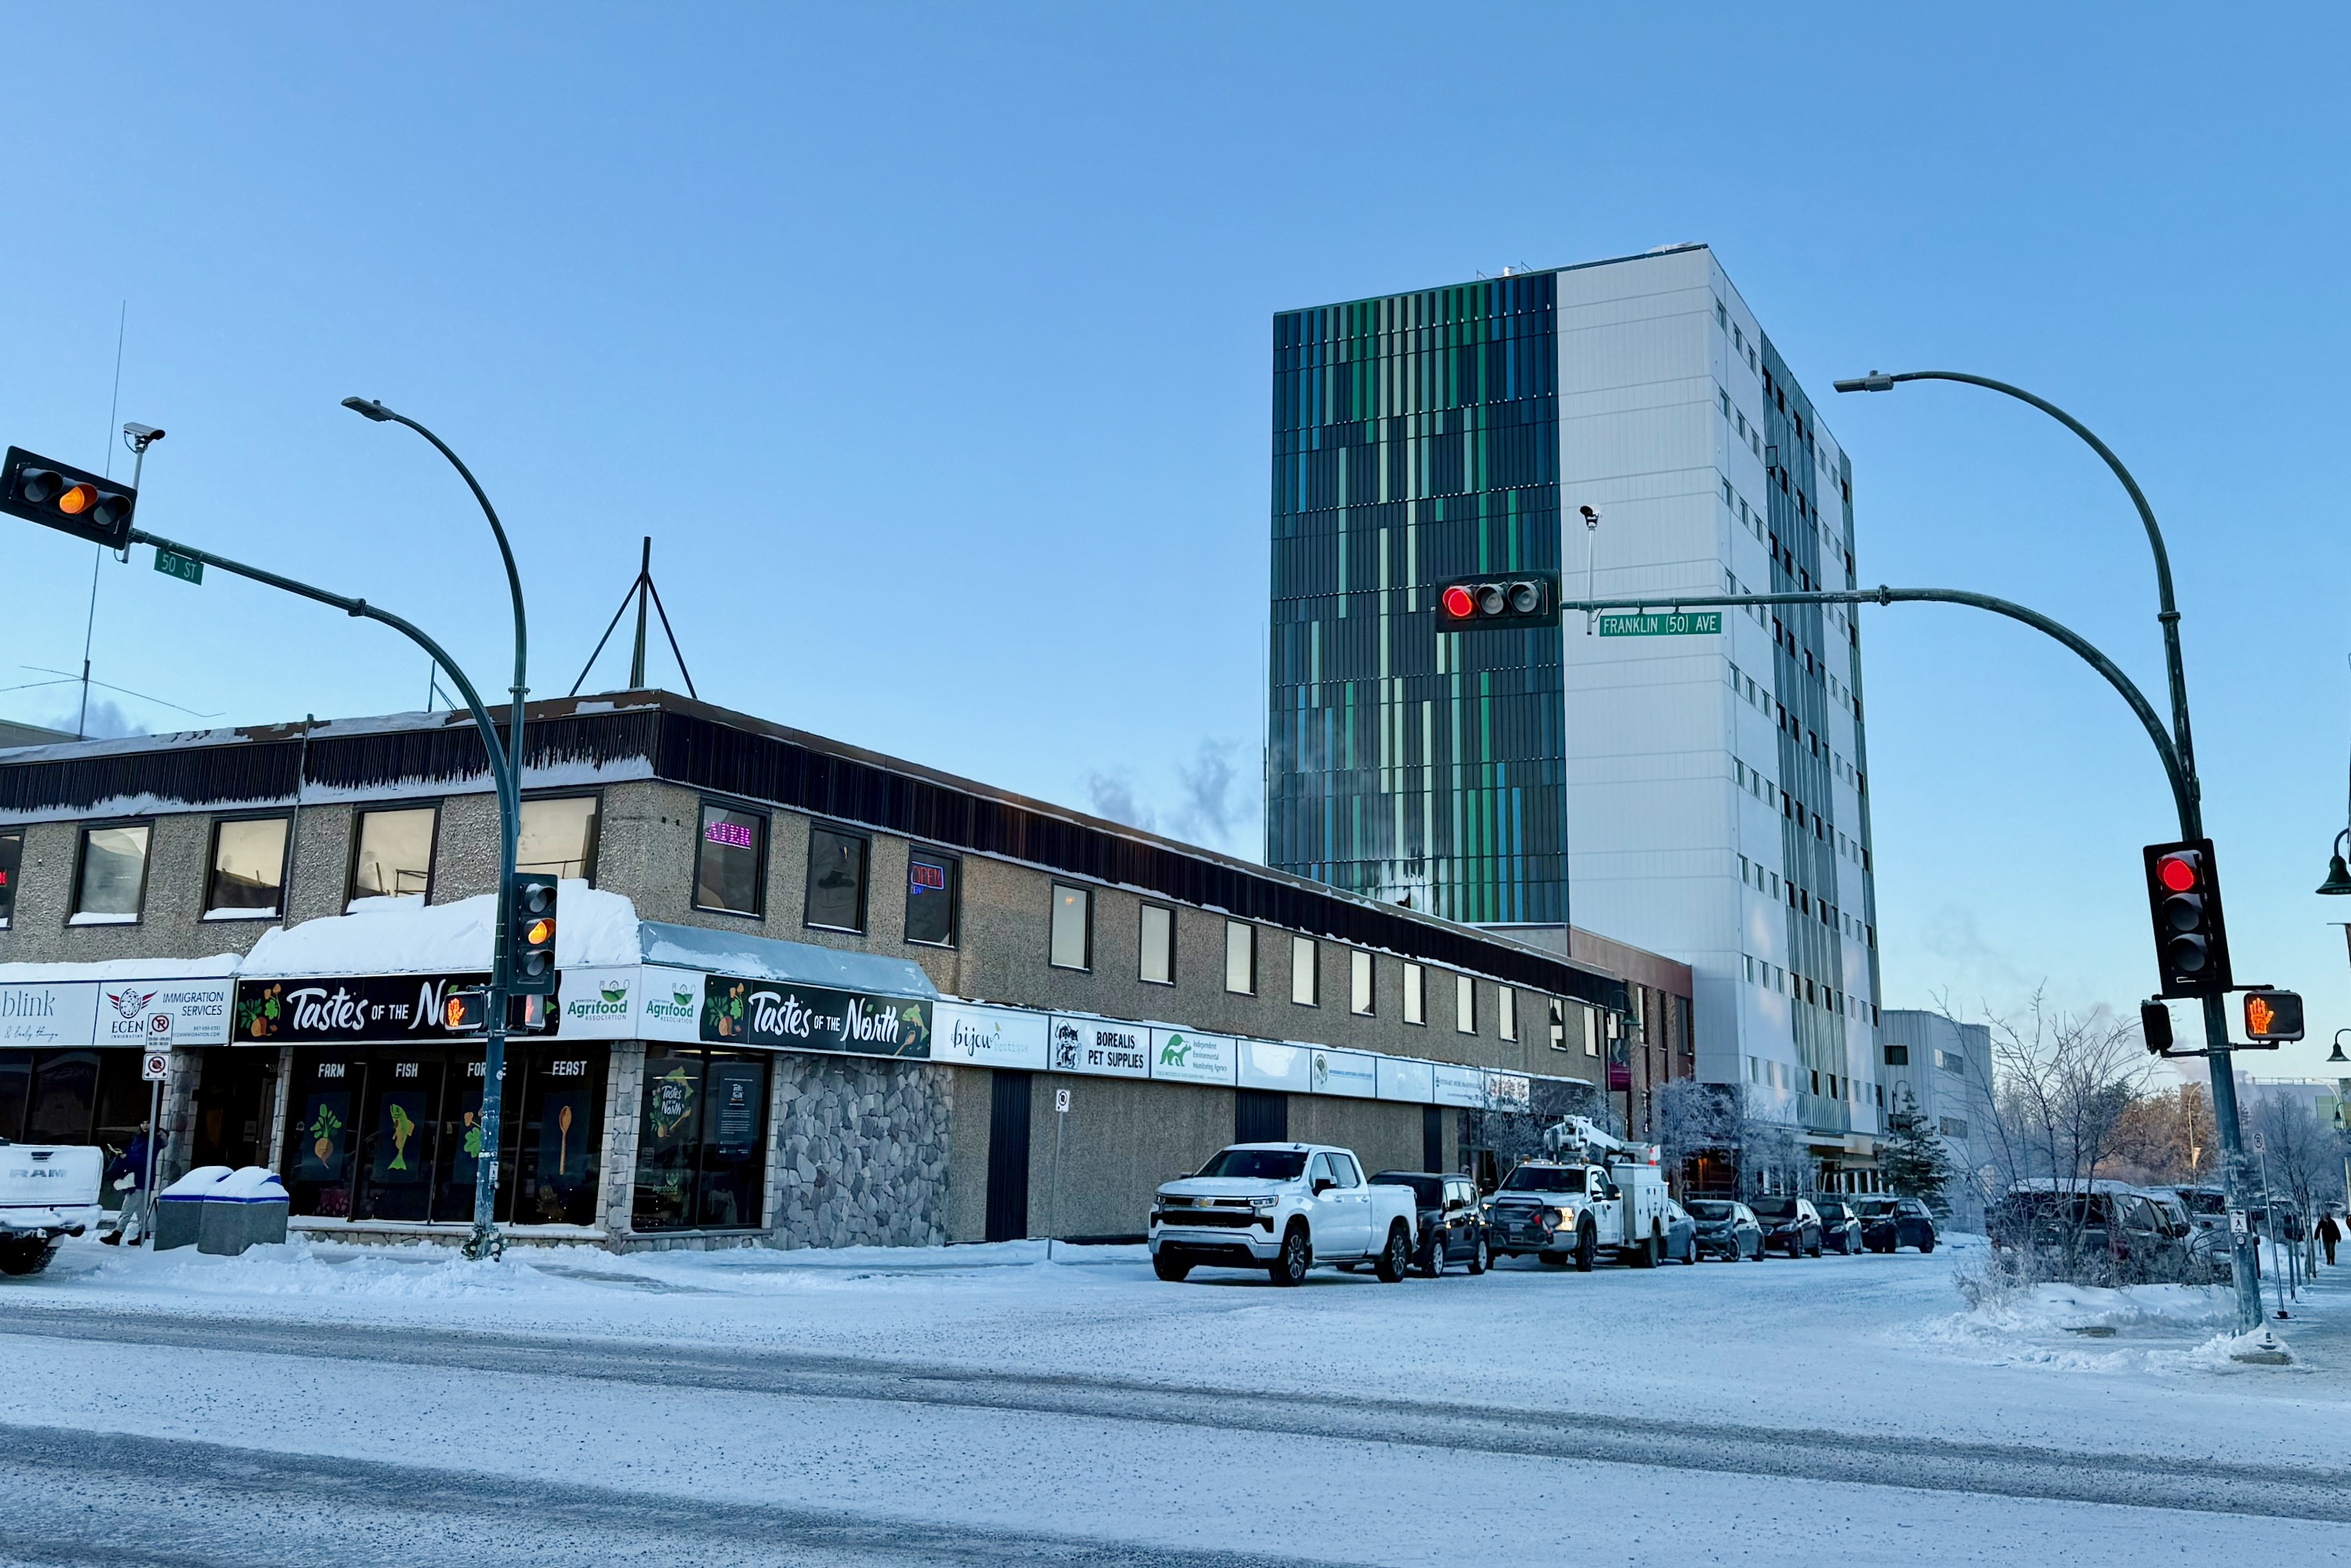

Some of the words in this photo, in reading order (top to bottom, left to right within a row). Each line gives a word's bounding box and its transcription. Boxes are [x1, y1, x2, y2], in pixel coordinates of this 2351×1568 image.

[161, 554, 176, 573] 50
[183, 562, 197, 579] ST
[1603, 617, 1658, 633] FRANKLIN
[1665, 615, 1689, 633] (50)
[1695, 615, 1717, 632] AVE
[913, 865, 942, 887] OPEN
[2, 990, 55, 1016] blink
[162, 991, 224, 1003] IMMIGRATION
[182, 1005, 223, 1016] SERVICES
[286, 987, 368, 1031] Tastes
[371, 1005, 385, 1020] OF
[389, 1004, 409, 1019] THE
[567, 1000, 628, 1018] Agrifood
[646, 1001, 694, 1018] Agrifood
[748, 991, 812, 1038] Tastes
[813, 1016, 824, 1030] OF
[826, 1016, 841, 1032] THE
[839, 998, 900, 1043] North
[111, 1020, 144, 1034] ECEN
[1096, 1031, 1135, 1049] BOREALIS
[552, 1060, 587, 1076] FEAST
[1089, 1050, 1103, 1065] PET
[1107, 1052, 1143, 1069] SUPPLIES
[318, 1063, 345, 1077] FARM
[396, 1063, 418, 1077] FISH
[467, 1061, 508, 1077] FORE
[661, 1085, 682, 1099] Tastes
[9, 1169, 67, 1178] RAM
